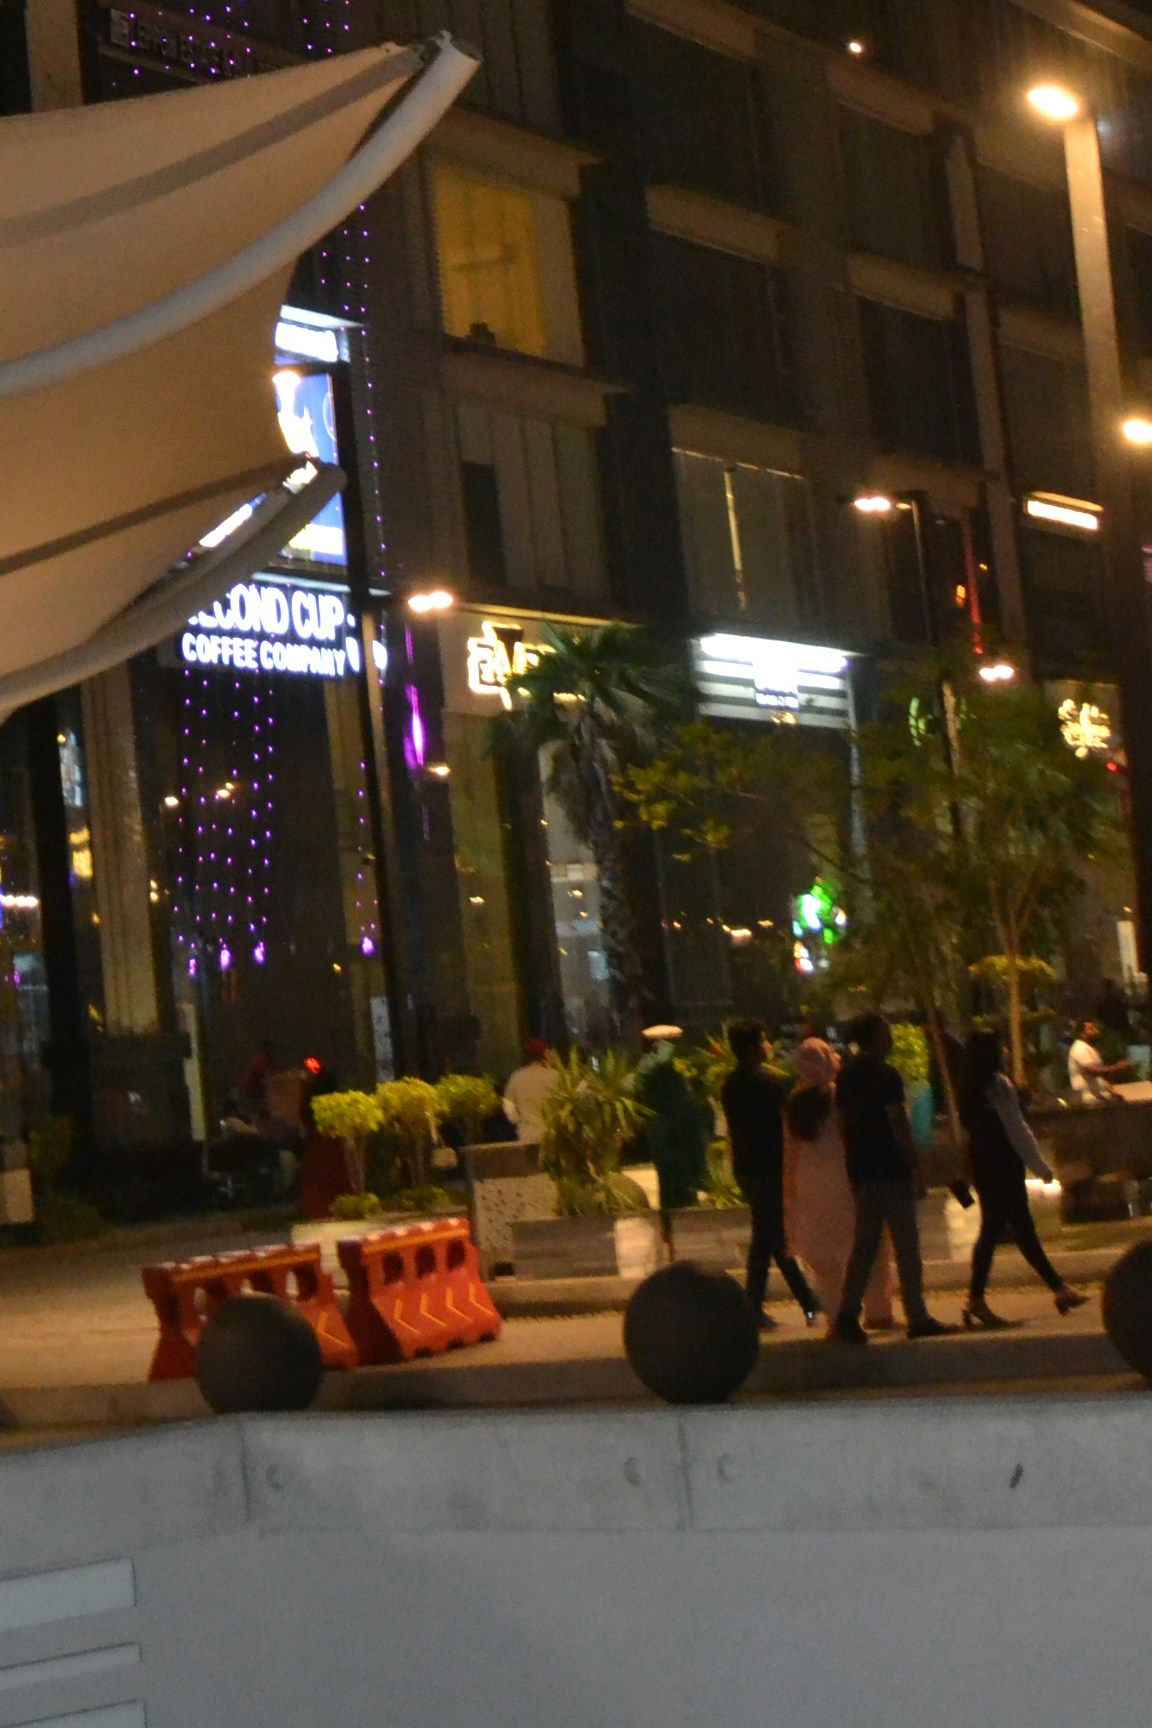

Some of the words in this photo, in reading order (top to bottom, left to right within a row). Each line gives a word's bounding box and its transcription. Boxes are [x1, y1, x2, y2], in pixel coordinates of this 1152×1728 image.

[291, 590, 346, 641] CUP
[181, 632, 259, 669] COFFEE
[259, 640, 346, 678] COMPANY
